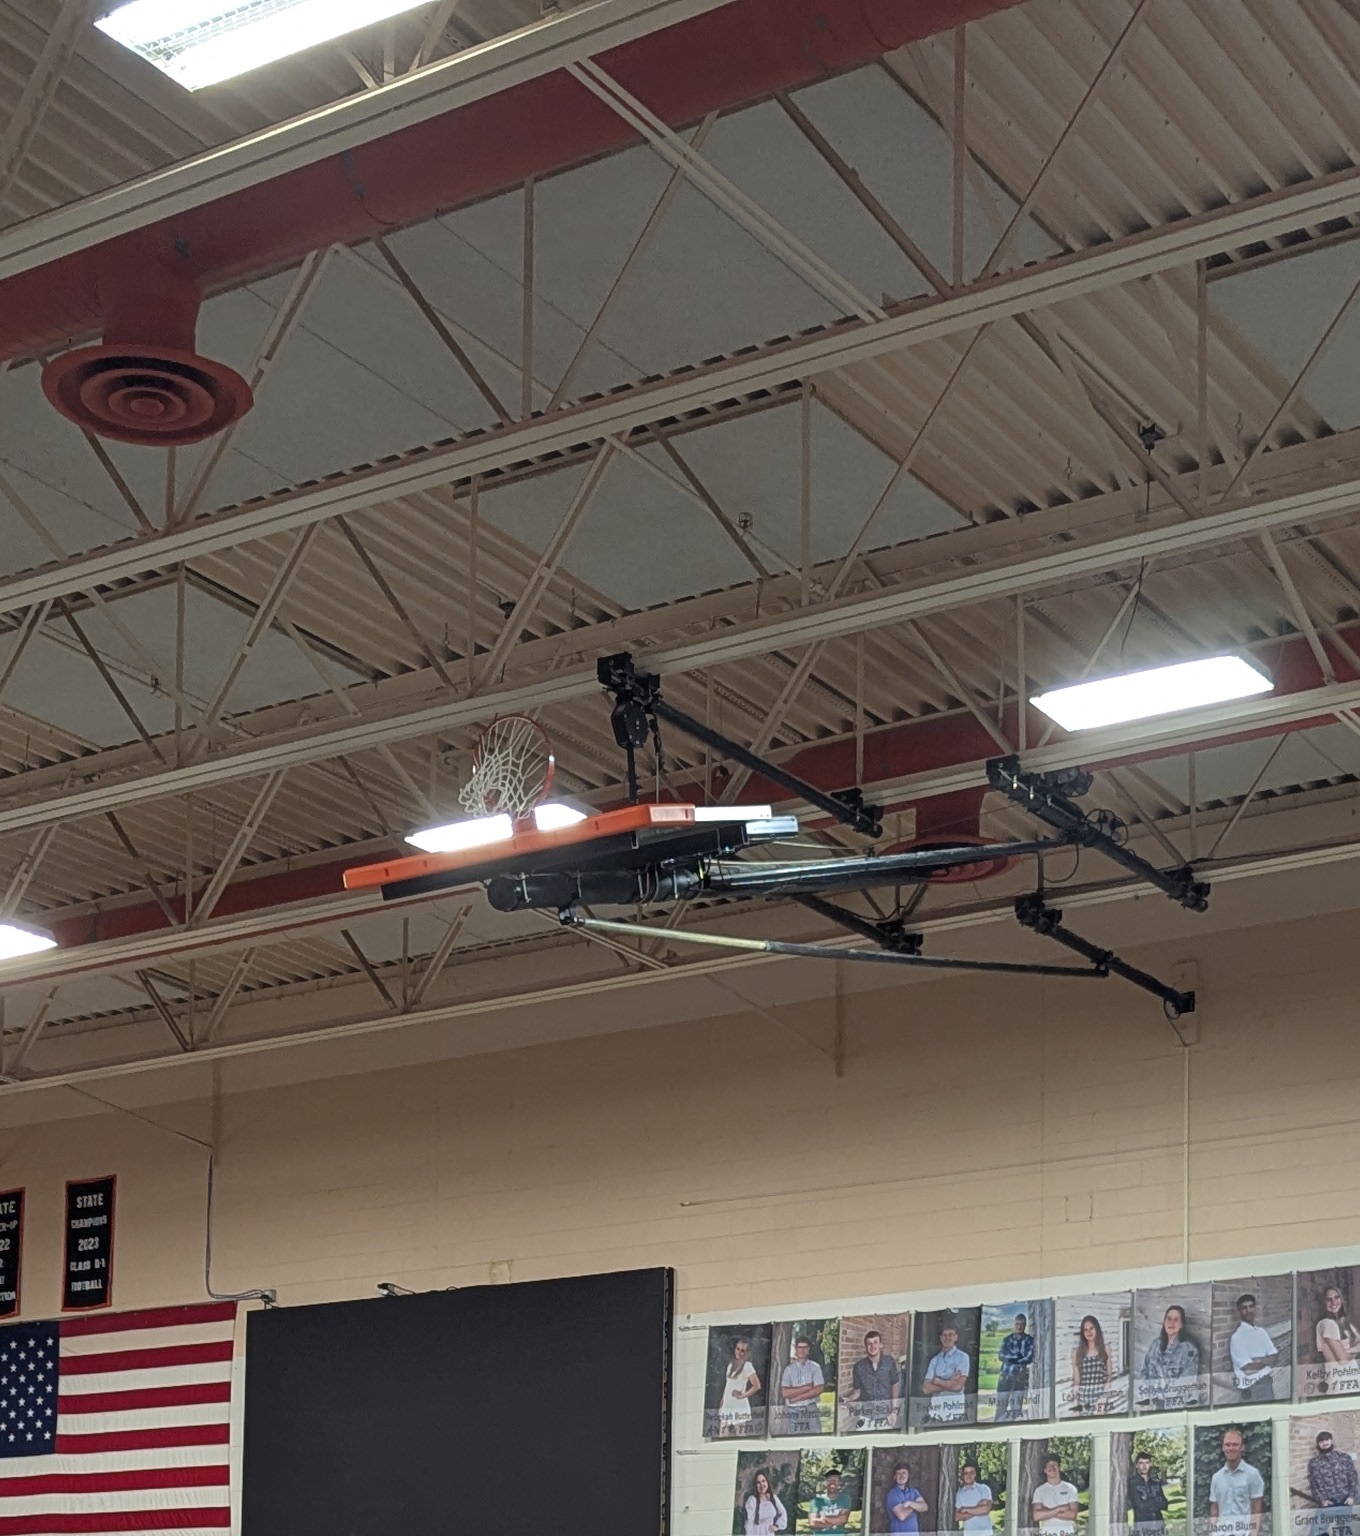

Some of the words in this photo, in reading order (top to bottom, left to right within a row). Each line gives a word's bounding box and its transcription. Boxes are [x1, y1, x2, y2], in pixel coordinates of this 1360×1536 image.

[76, 1193, 104, 1209] STATE
[78, 1237, 100, 1252] 2023
[1306, 1369, 1330, 1379] Kelby
[1339, 1379, 1360, 1391] FFA
[794, 1422, 811, 1432] FFA
[1295, 1514, 1318, 1526] Grant
[1209, 1522, 1234, 1533] Jaron
[1332, 1526, 1352, 1536] FFA
